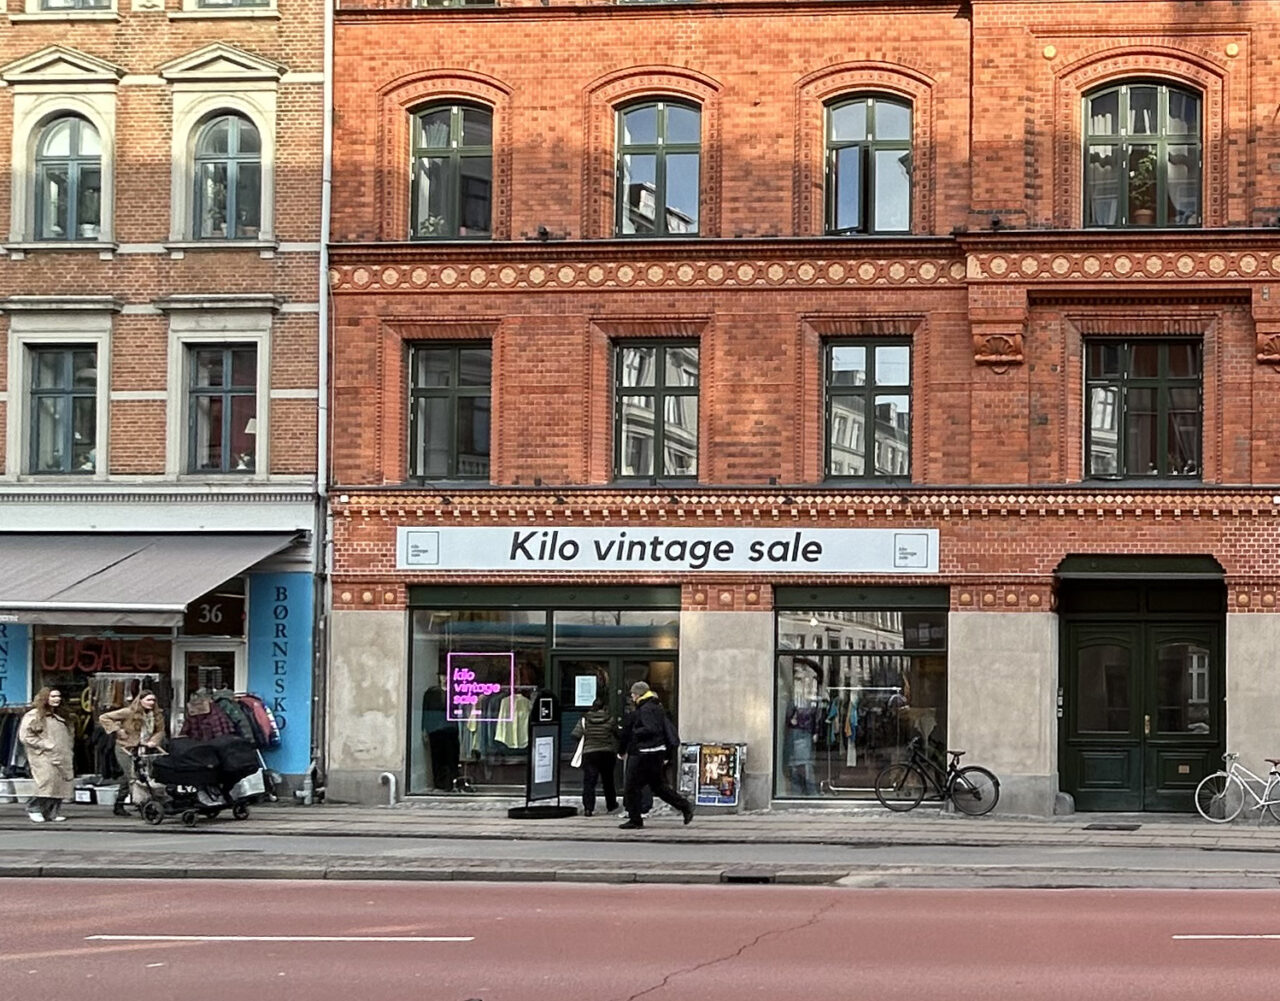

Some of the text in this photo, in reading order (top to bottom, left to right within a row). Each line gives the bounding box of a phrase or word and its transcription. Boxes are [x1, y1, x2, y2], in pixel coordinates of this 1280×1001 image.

[509, 530, 823, 570] Kilo vintage sale
[198, 603, 223, 624] 36
[41, 636, 156, 671] UDSALG
[453, 667, 475, 681] kilo
[453, 680, 501, 696] vintage
[453, 694, 478, 705] sale
